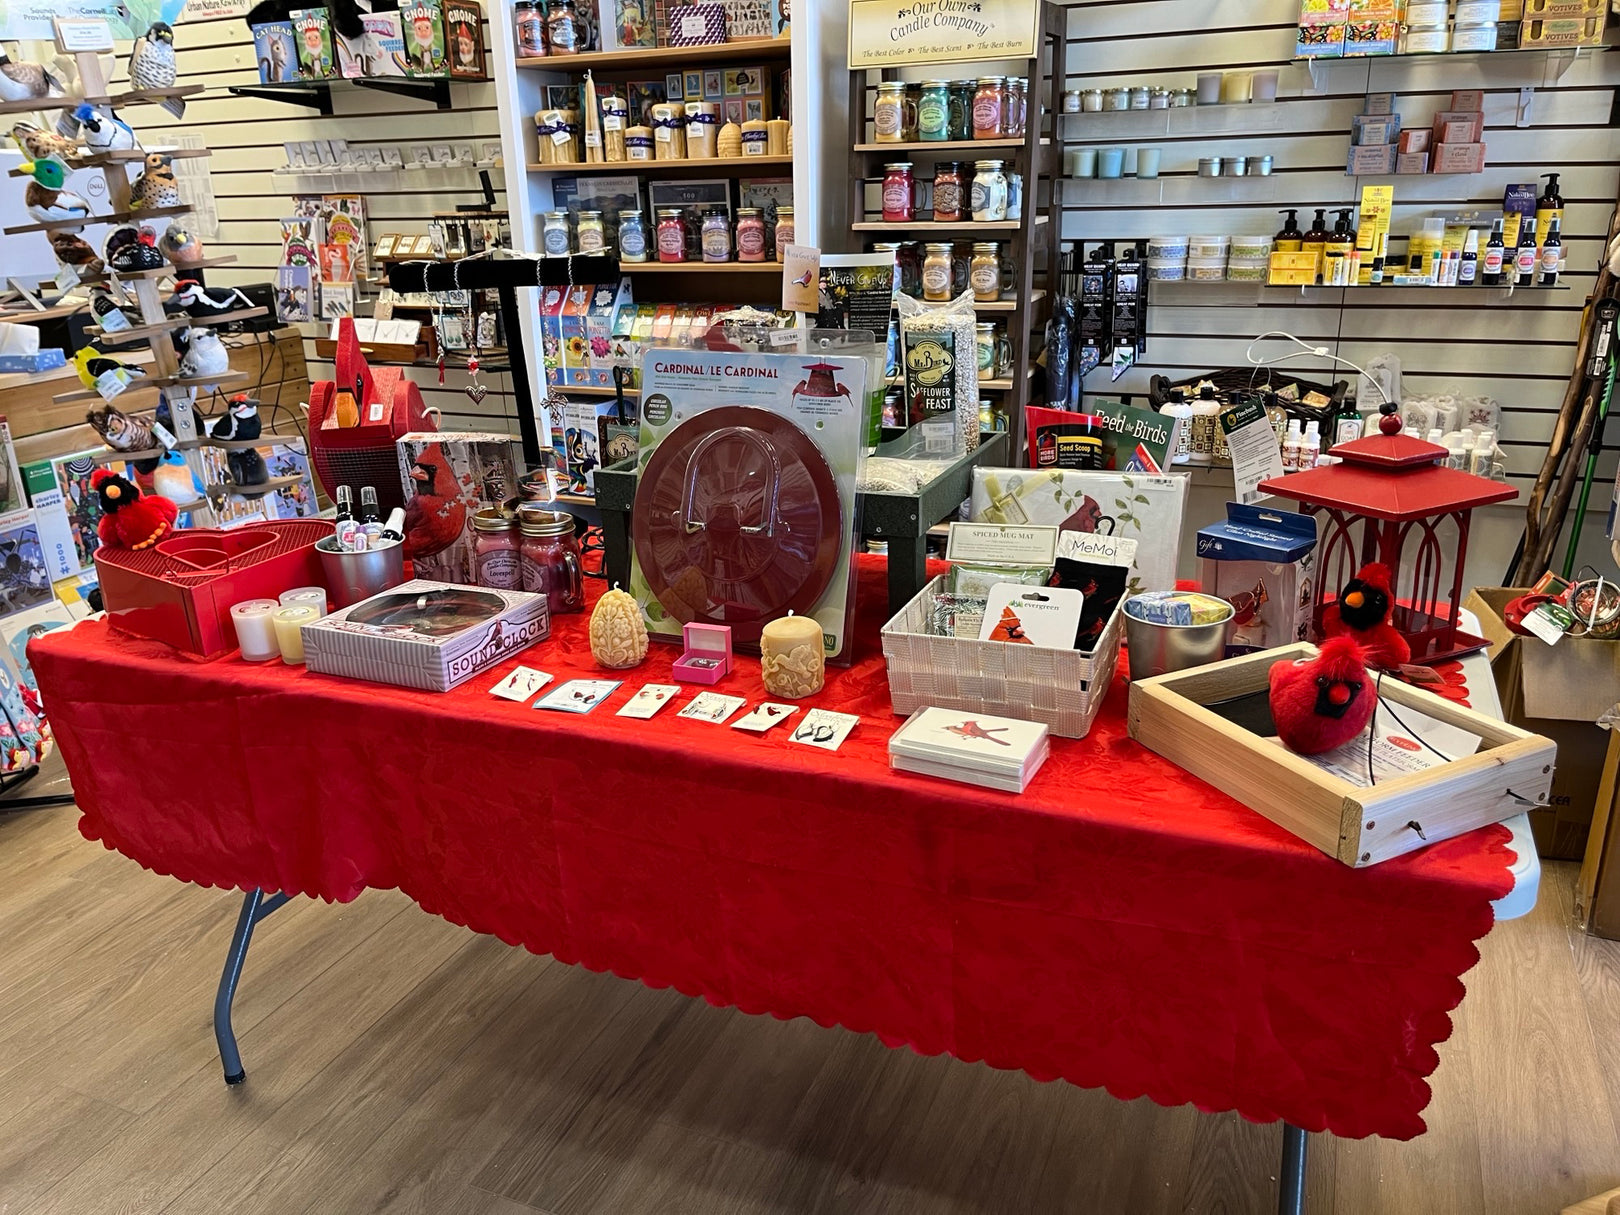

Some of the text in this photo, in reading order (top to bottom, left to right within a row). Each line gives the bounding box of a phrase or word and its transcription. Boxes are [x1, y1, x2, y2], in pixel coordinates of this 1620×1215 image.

[404, 8, 438, 22] GNOME
[912, 0, 966, 16] Our Own
[296, 17, 326, 32] GNOME
[448, 9, 478, 26] GNOME
[256, 25, 292, 40] CAT HEAD
[890, 12, 989, 42] Candle Company
[1546, 32, 1578, 40] VOTIVES
[874, 48, 888, 57] Best
[888, 48, 905, 56] Color
[918, 46, 929, 54] The
[945, 44, 962, 52] Scent
[1006, 40, 1023, 48] Burn
[724, 366, 779, 379] CARDINAL
[926, 398, 952, 410] FEAST
[1095, 409, 1125, 434] Feed
[1133, 422, 1168, 446] Birds
[1060, 444, 1091, 452] Seed Scoop
[1072, 540, 1118, 556] MeMoi
[1199, 538, 1215, 554] Gift
[1024, 602, 1059, 611] evergreen
[452, 644, 496, 676] SOUND
[503, 618, 544, 649] CLOCK
